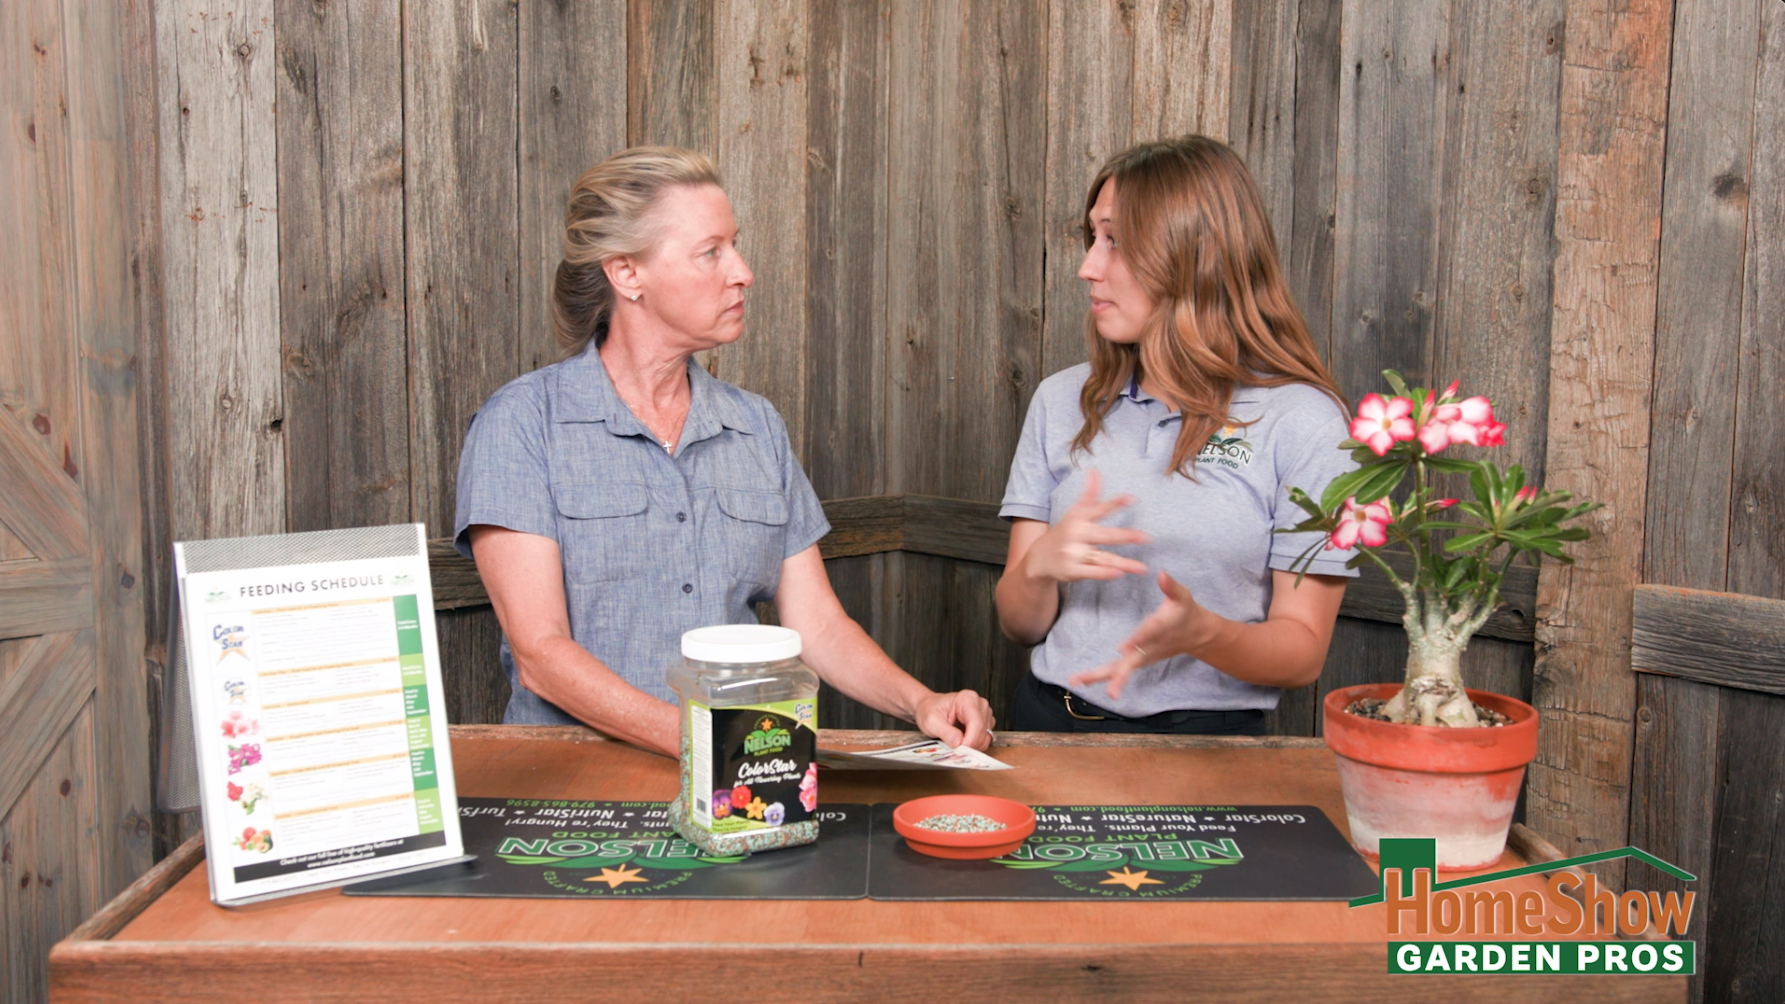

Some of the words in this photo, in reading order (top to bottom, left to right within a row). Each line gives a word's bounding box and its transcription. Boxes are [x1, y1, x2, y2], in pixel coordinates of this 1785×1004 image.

[1196, 443, 1252, 465] ELSON
[1217, 457, 1239, 469] FOOD
[240, 581, 305, 597] FEEDING
[311, 575, 384, 591] SCHEDULE
[744, 735, 791, 755] NELSON
[754, 749, 768, 757] PLANT
[738, 758, 797, 779] ColorStar
[506, 800, 595, 808] 979-865-8596
[458, 806, 506, 817] TurfS
[535, 808, 615, 819] NutriStar
[1070, 805, 1237, 814] www.nelsonplantfood.com
[504, 818, 567, 827] Hungry!
[572, 819, 629, 829] They're
[1101, 814, 1197, 824] NatureStar
[1225, 814, 1307, 824] ColorStar
[1037, 824, 1096, 833] They're
[1104, 823, 1153, 833] Plants.
[1161, 824, 1196, 833] Your
[1199, 824, 1237, 833] Feed
[552, 831, 619, 839] FOOD
[628, 830, 677, 839] ANT
[1028, 835, 1096, 843] FOOD
[1105, 833, 1178, 842] PLANT
[498, 837, 710, 858] ELSON
[543, 870, 604, 895] CRAFTED
[613, 871, 693, 895] PREMIUM
[1053, 874, 1131, 898] CRAFTED
[1139, 874, 1203, 898] PREMIUM
